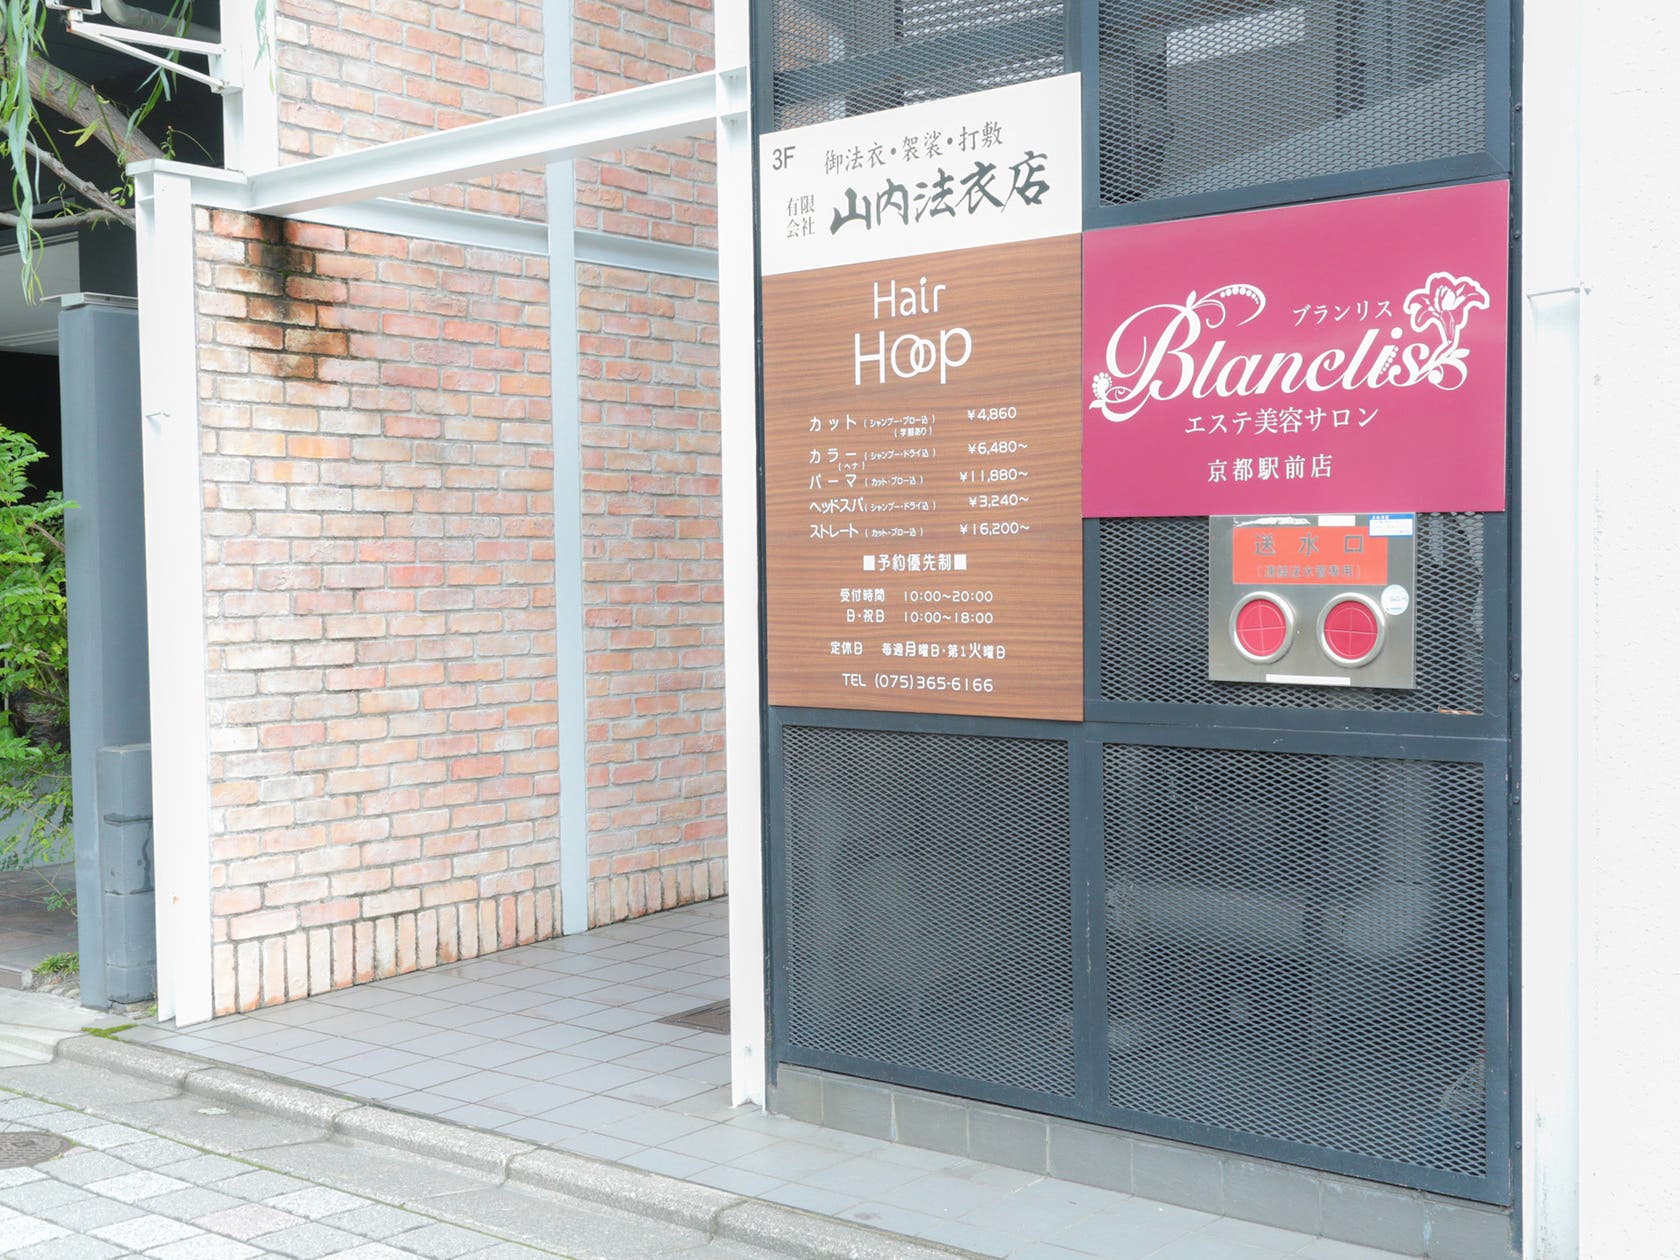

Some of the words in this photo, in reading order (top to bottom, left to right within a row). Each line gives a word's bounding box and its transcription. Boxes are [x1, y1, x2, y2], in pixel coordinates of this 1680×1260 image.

[772, 145, 796, 171] 3F
[830, 150, 1050, 235] 山内法衣店
[787, 194, 815, 217] 有限
[787, 216, 816, 239] 会社
[874, 276, 946, 319] Hair
[1292, 299, 1393, 328] ブランリス
[809, 414, 857, 432] カット
[967, 406, 1017, 421] ¥4,860
[1184, 406, 1379, 435] エステ美容サロン
[809, 448, 857, 464] カラー
[1207, 452, 1333, 483] 京都駅前店
[809, 474, 857, 489] パーマ
[809, 496, 864, 514] ヘッドスパ
[810, 523, 859, 539] ストレート
[840, 588, 886, 603] 受付時間
[830, 641, 863, 655] 定休日
[842, 673, 866, 687] TEL
